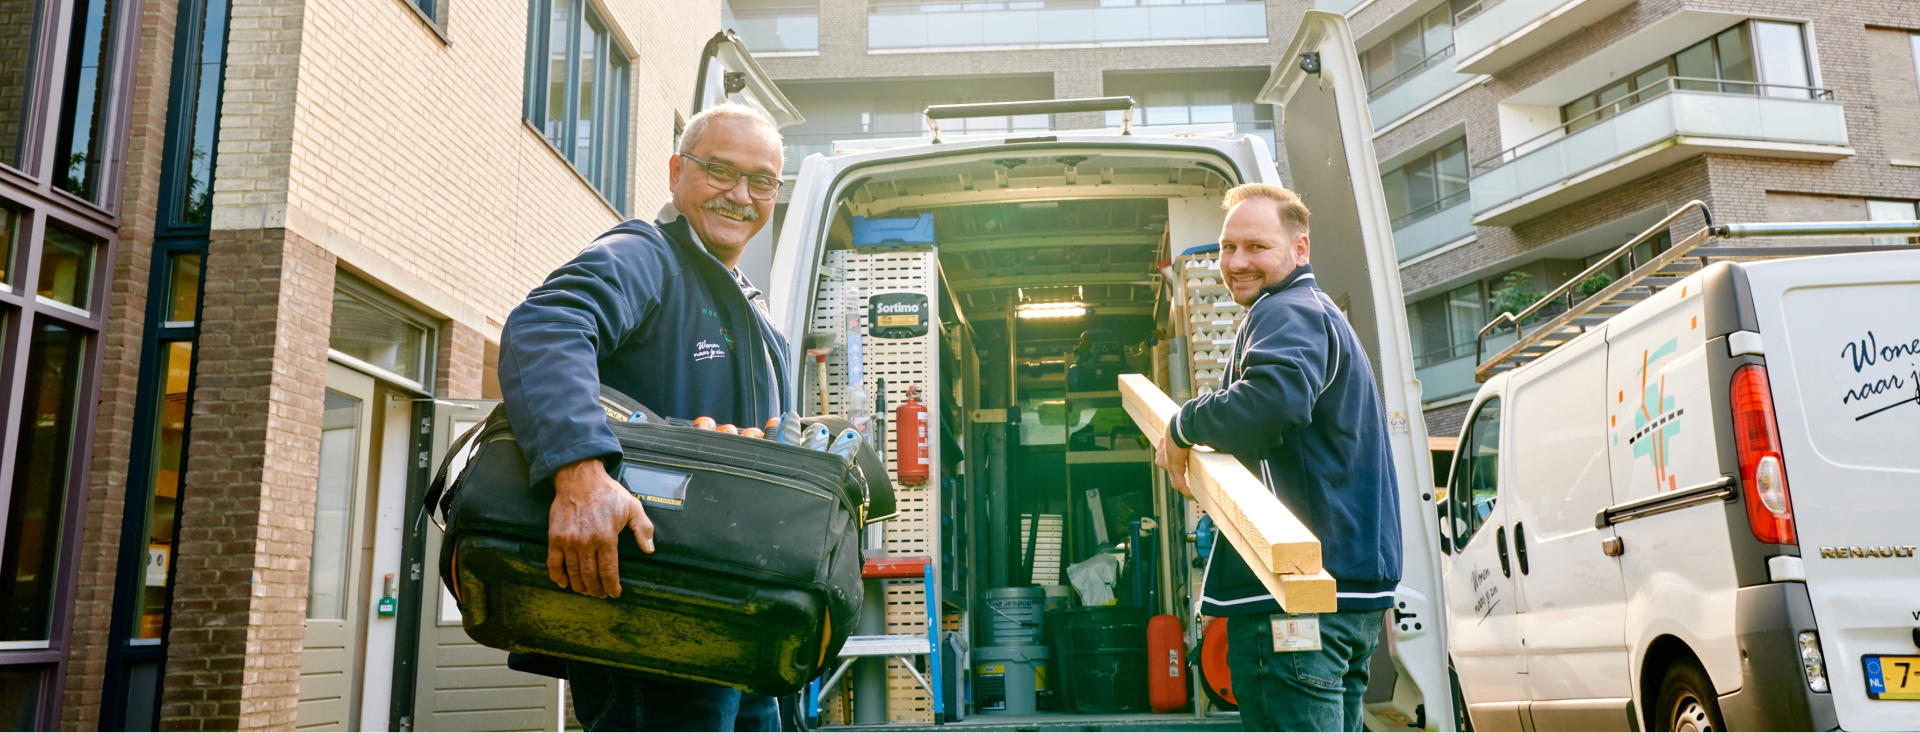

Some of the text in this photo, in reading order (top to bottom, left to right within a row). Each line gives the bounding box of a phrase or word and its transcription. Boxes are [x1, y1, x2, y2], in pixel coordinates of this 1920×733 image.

[877, 302, 919, 313] Sortimo
[1841, 330, 1920, 373] Wone
[1843, 363, 1920, 406] naar j
[1820, 545, 1917, 559] RENAULT
[1869, 678, 1883, 687] NL
